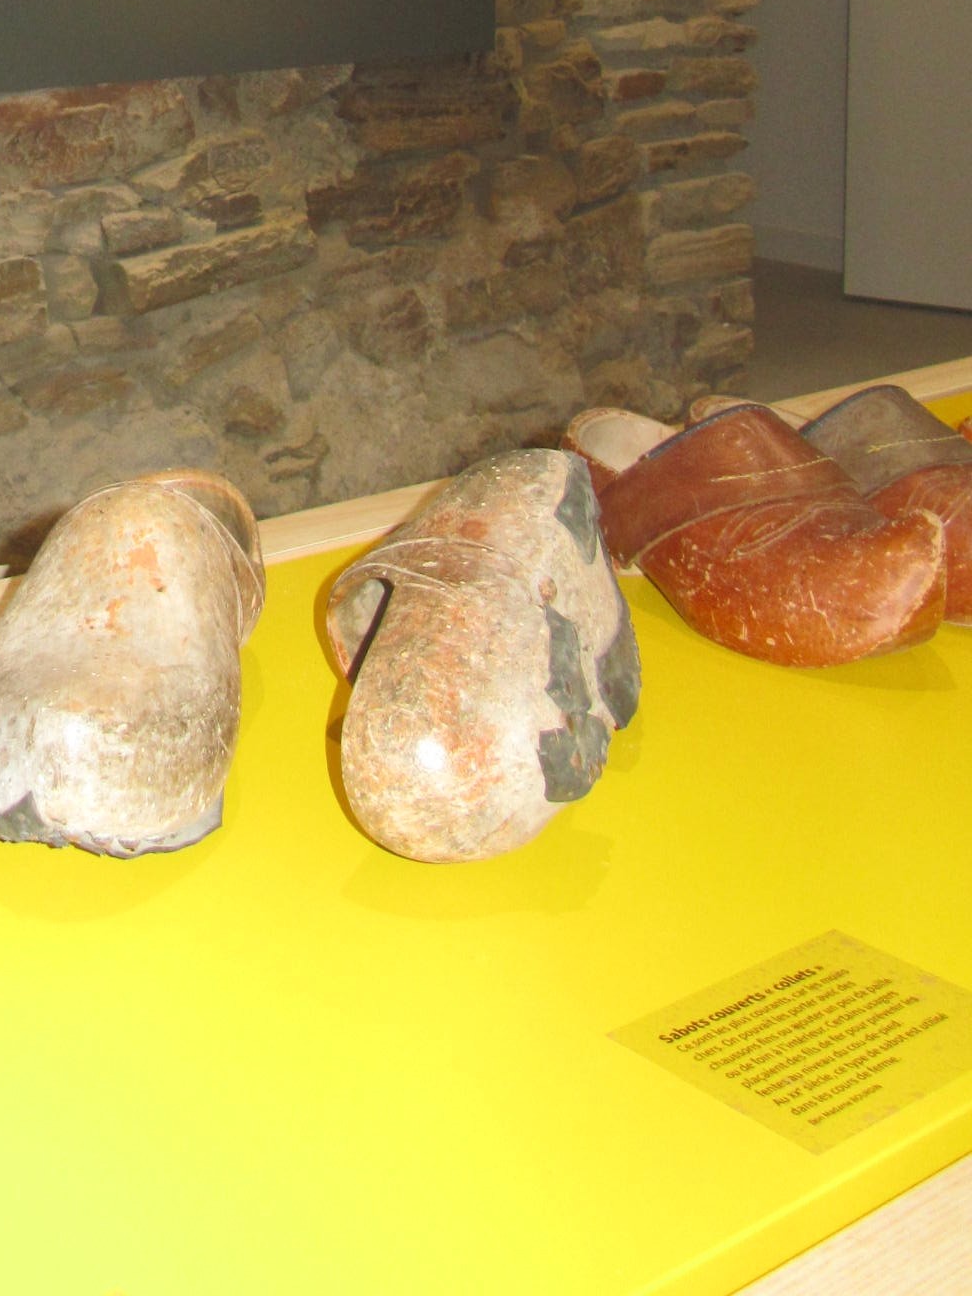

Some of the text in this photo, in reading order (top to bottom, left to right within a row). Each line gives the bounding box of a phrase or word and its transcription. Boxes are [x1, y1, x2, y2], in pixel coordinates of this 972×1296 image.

[658, 1018, 710, 1043] Sabots
[708, 992, 766, 1021] couverts
[772, 968, 816, 990] collets
